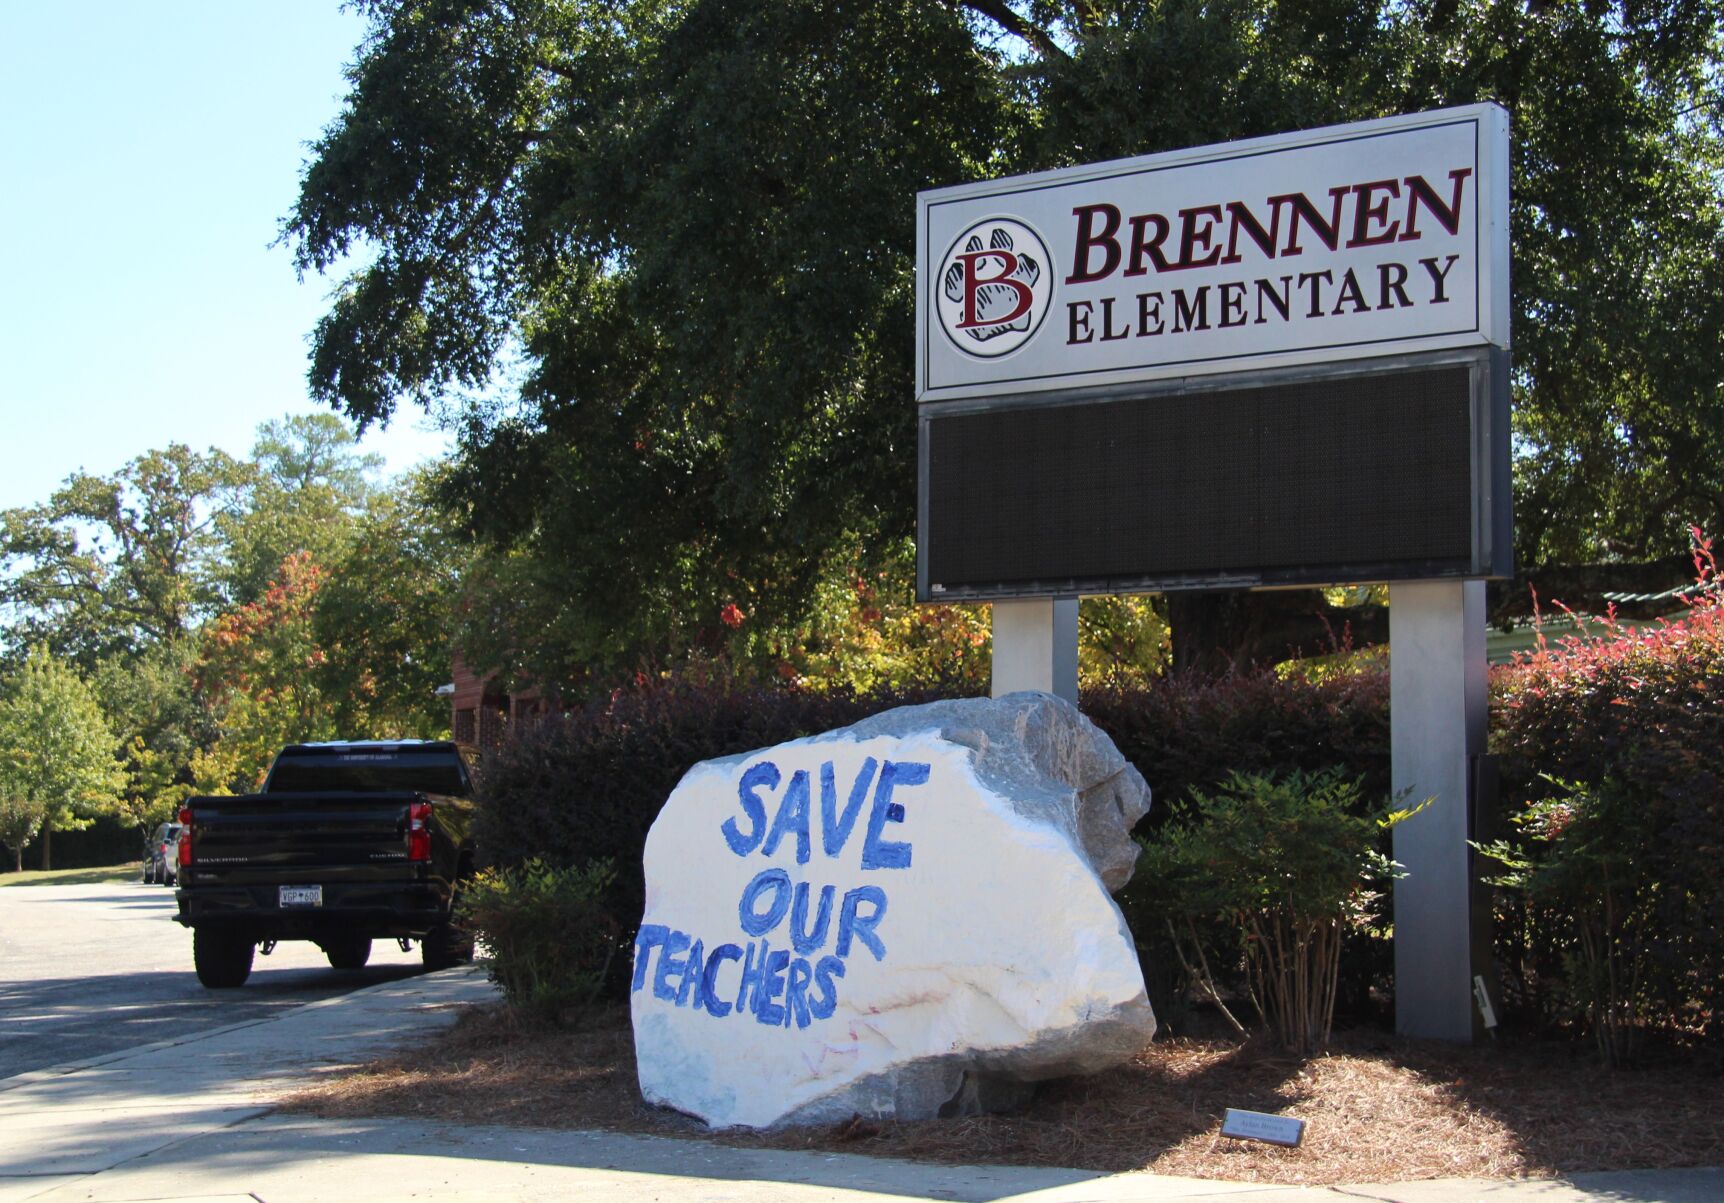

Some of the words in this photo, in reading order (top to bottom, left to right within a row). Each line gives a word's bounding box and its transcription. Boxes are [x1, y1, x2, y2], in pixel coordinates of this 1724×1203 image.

[1065, 167, 1472, 285] BRENNEN
[955, 250, 1033, 329] B
[1066, 254, 1459, 346] ELEMENTARY
[721, 756, 931, 870] SAVE
[739, 867, 889, 961] OUR
[632, 923, 846, 1031] TEACHERS
